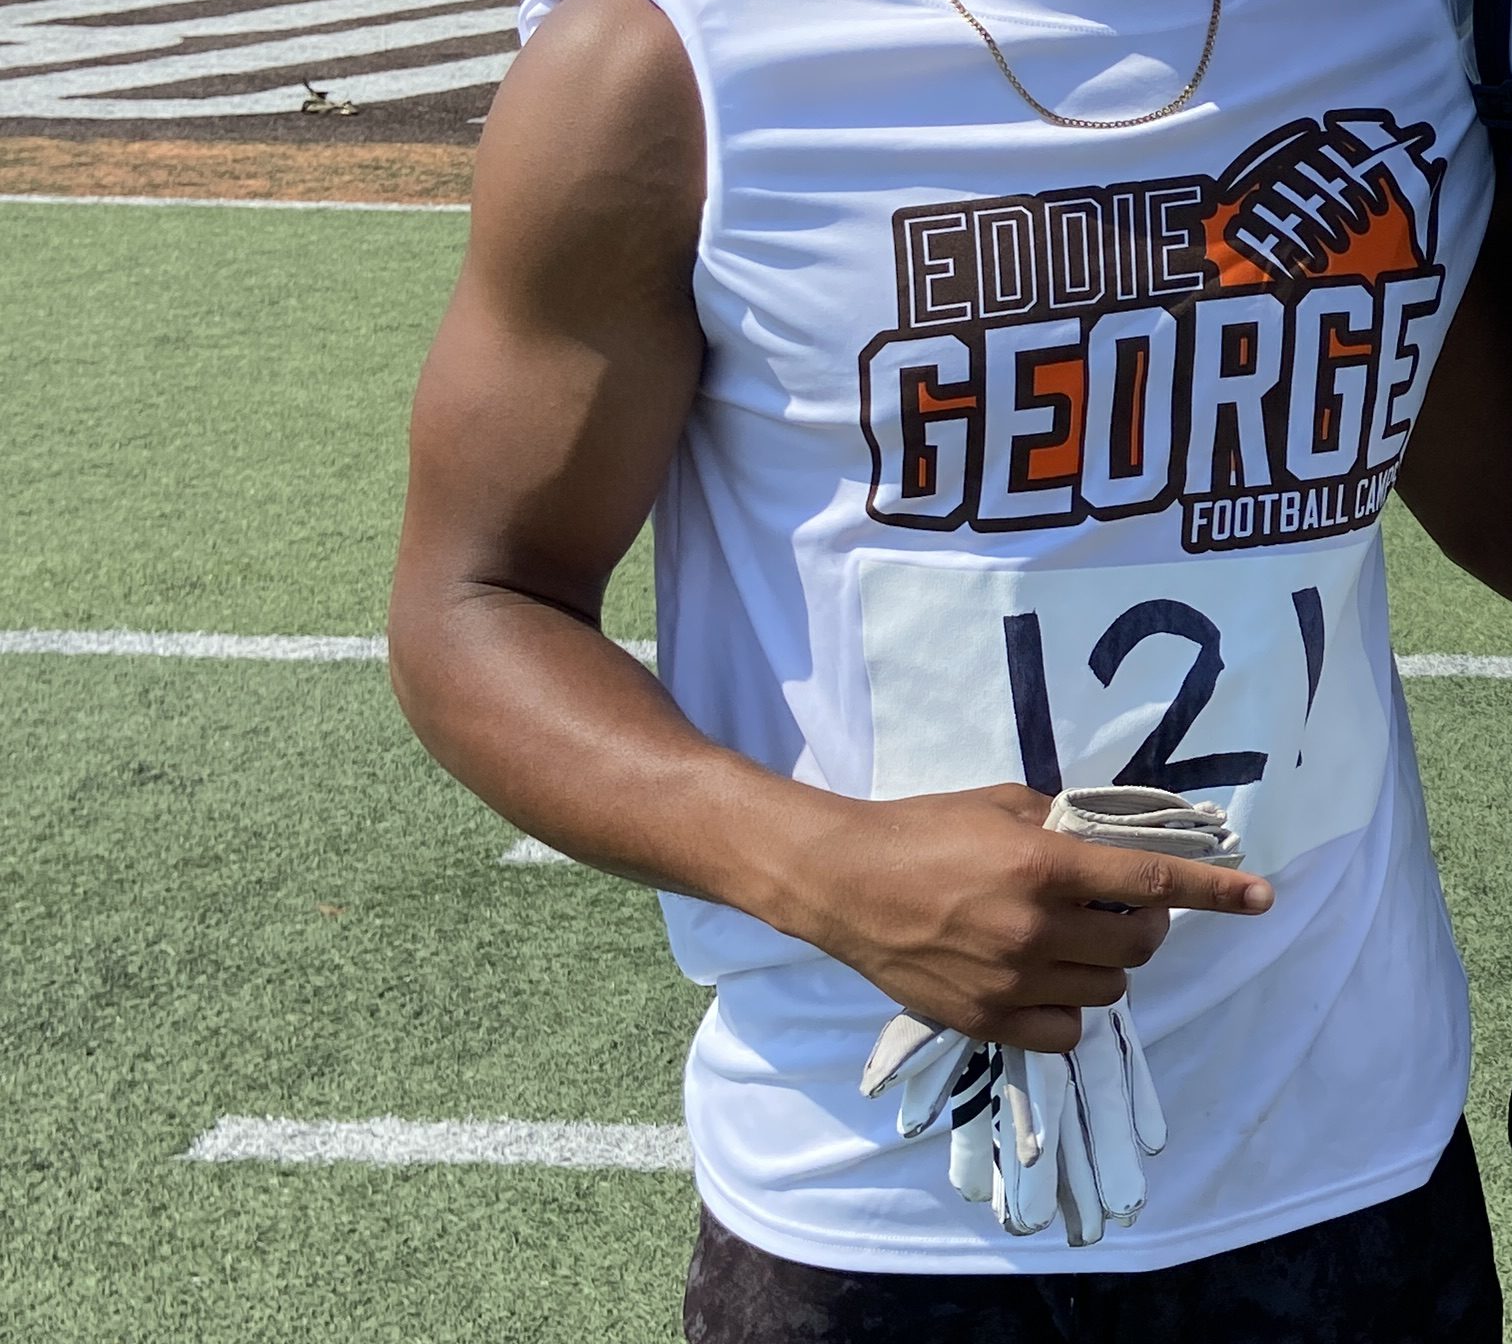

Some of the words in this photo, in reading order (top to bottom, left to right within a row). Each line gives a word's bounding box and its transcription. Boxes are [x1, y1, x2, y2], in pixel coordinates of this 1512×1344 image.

[903, 186, 1204, 329] EDDIE
[865, 274, 1442, 522] GEORGE
[1190, 483, 1350, 544] FOOTBALL
[1354, 460, 1401, 519] CAMP
